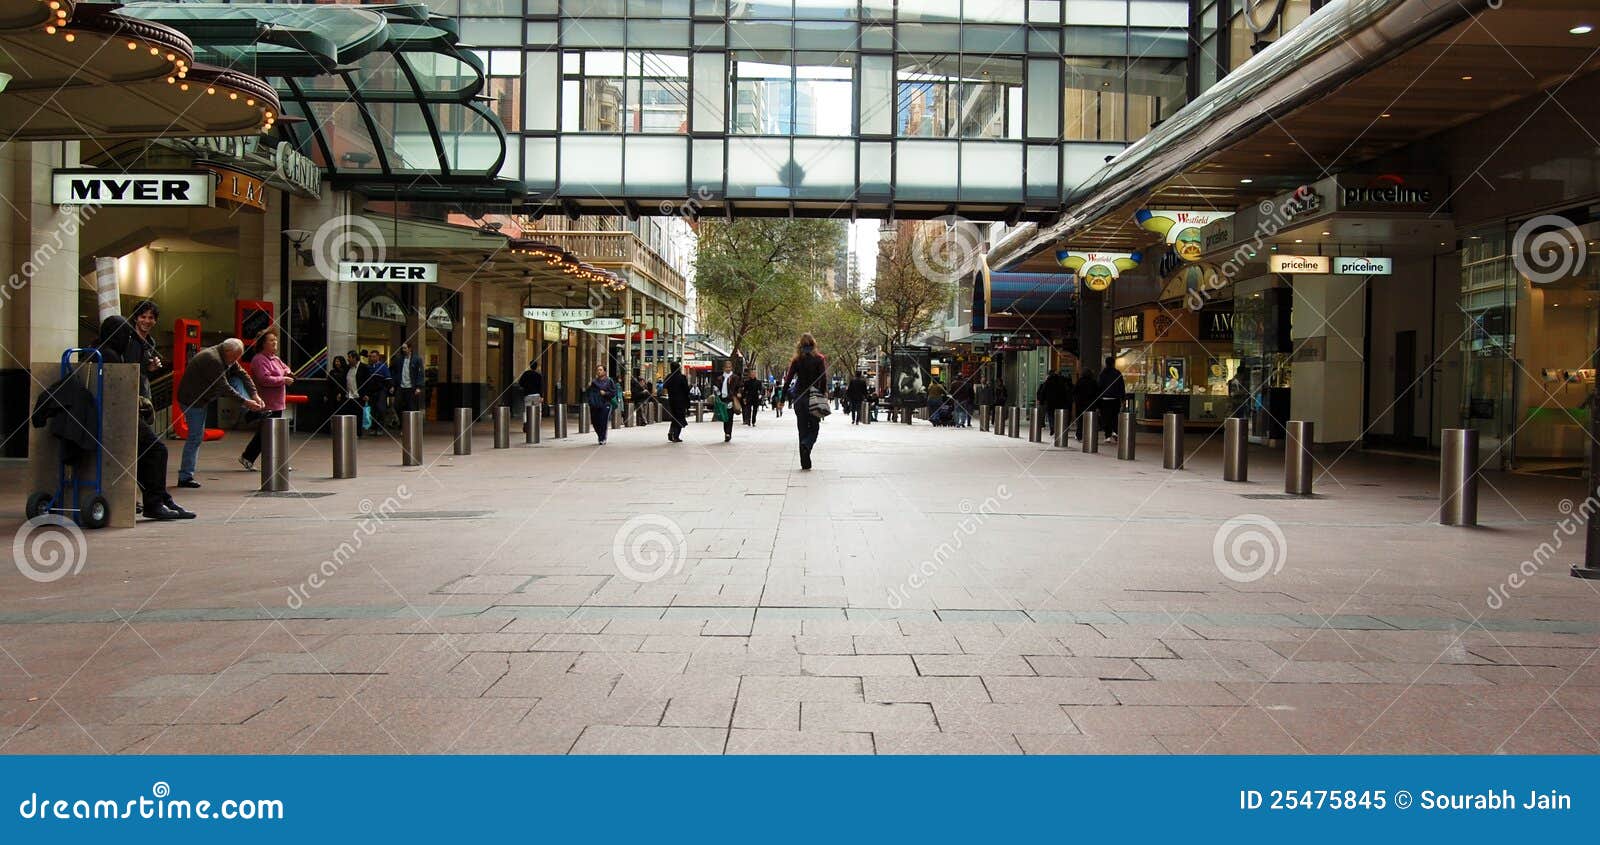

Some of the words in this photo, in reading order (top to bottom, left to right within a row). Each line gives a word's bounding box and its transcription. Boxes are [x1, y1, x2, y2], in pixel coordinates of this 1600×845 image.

[71, 179, 190, 201] MYER
[1343, 184, 1432, 206] priceline
[1177, 213, 1209, 224] Westfield
[350, 265, 426, 279] MYER
[1281, 260, 1320, 271] priceline
[1341, 261, 1384, 273] priceline
